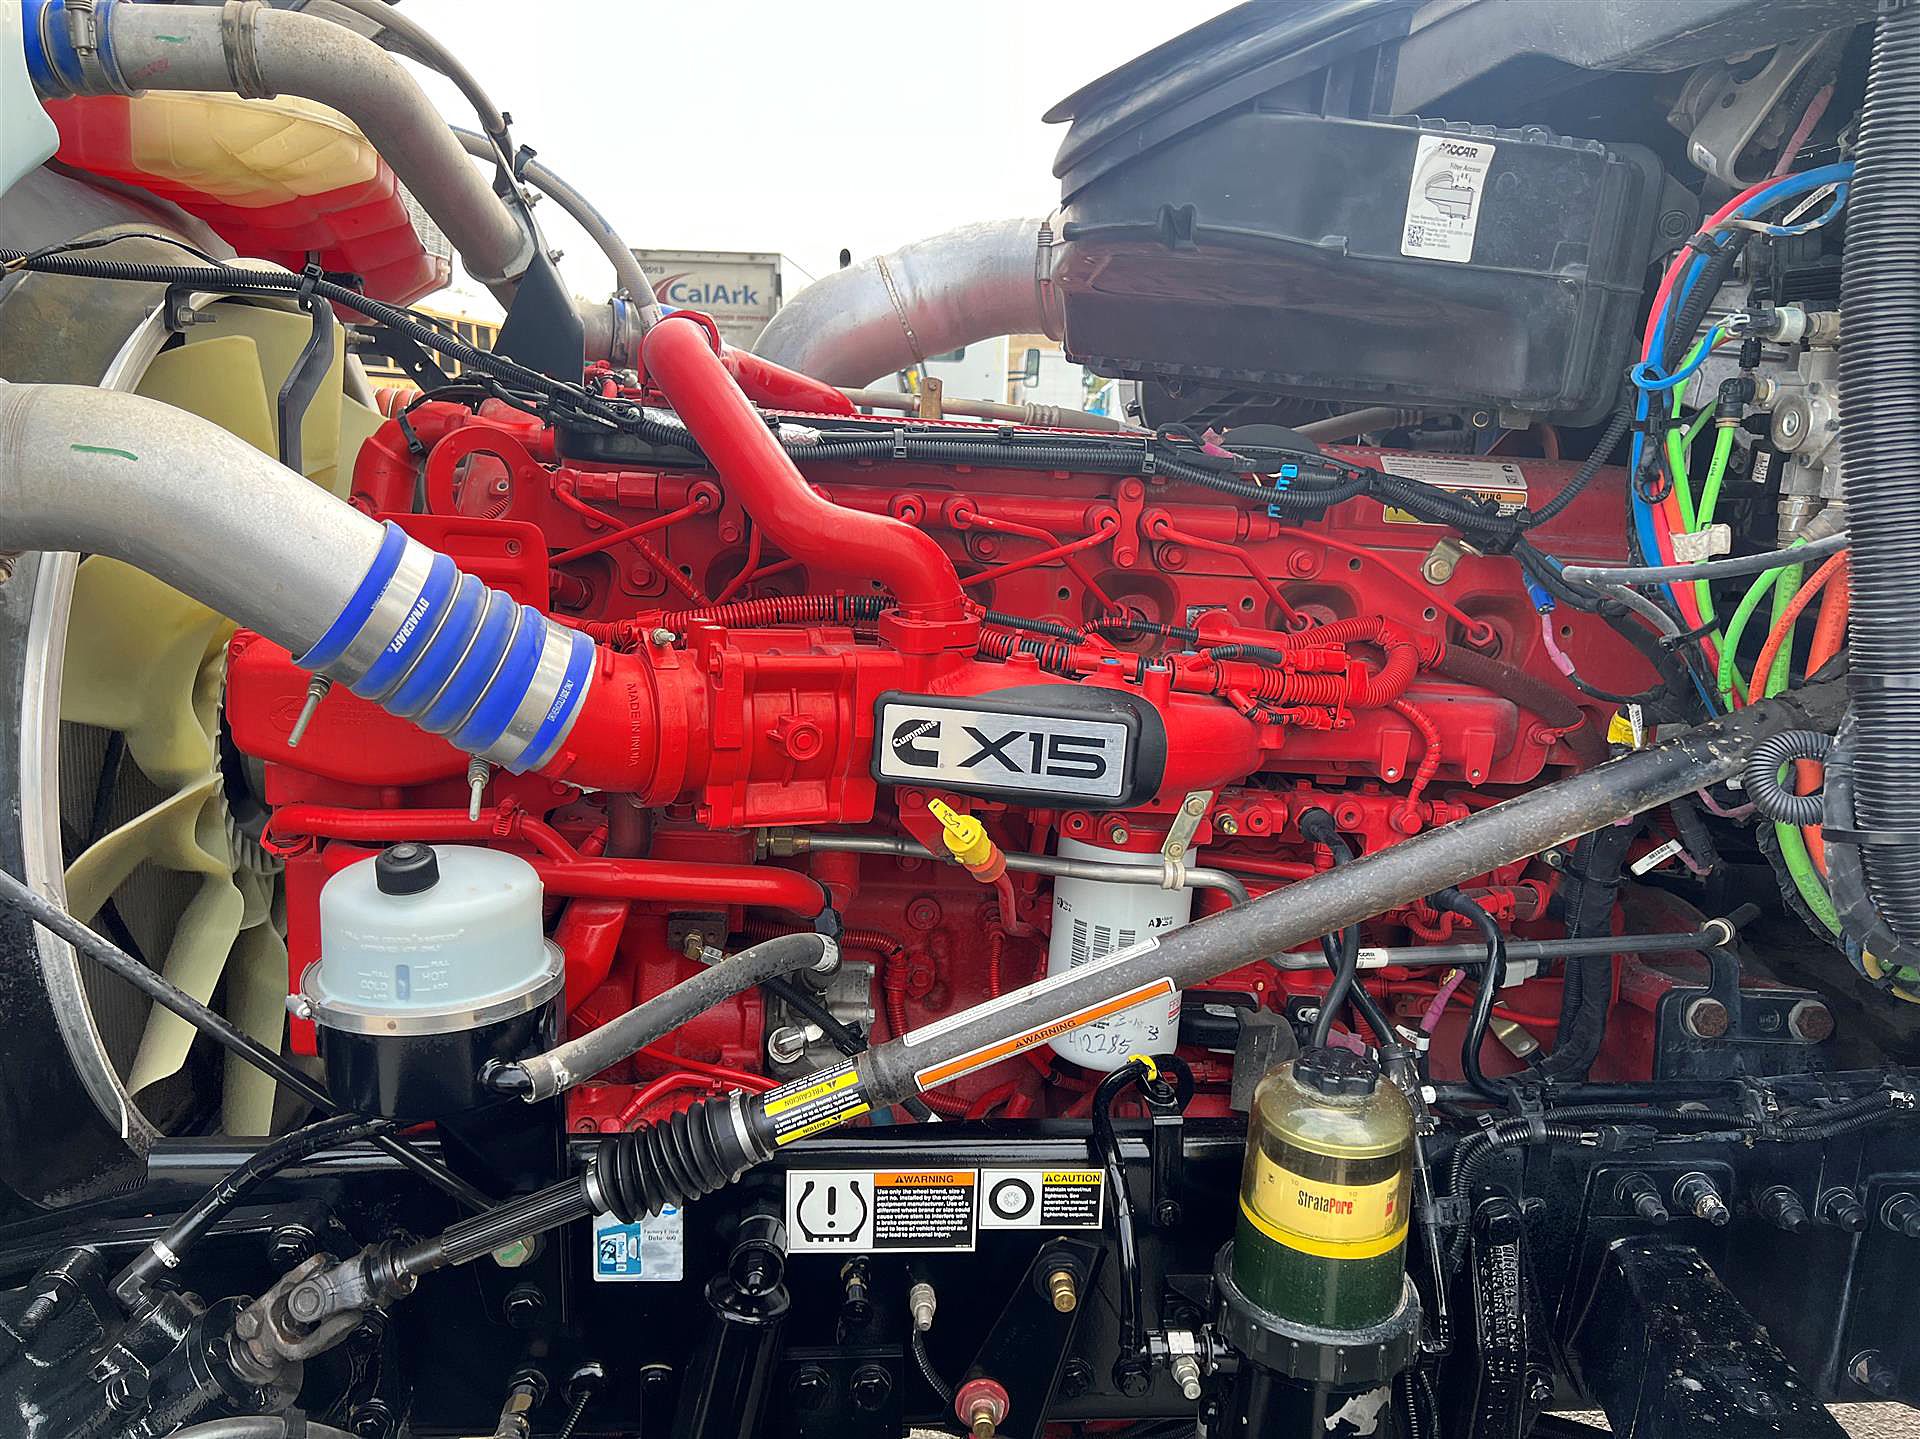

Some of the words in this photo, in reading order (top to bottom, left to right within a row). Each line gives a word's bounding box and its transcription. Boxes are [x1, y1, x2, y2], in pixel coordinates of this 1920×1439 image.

[669, 283, 758, 305] CalArk
[390, 597, 430, 654] DYNACRAFT
[626, 683, 640, 718] MADE
[631, 721, 640, 732] IN
[891, 719, 938, 748] Cummins
[957, 726, 1107, 780] X15
[1022, 1019, 1078, 1045] WARNING
[802, 1120, 831, 1134] CAUTION
[904, 1175, 954, 1183] WARNING
[1054, 1174, 1100, 1182] CAUTION
[1297, 1190, 1353, 1215] StrataPore
